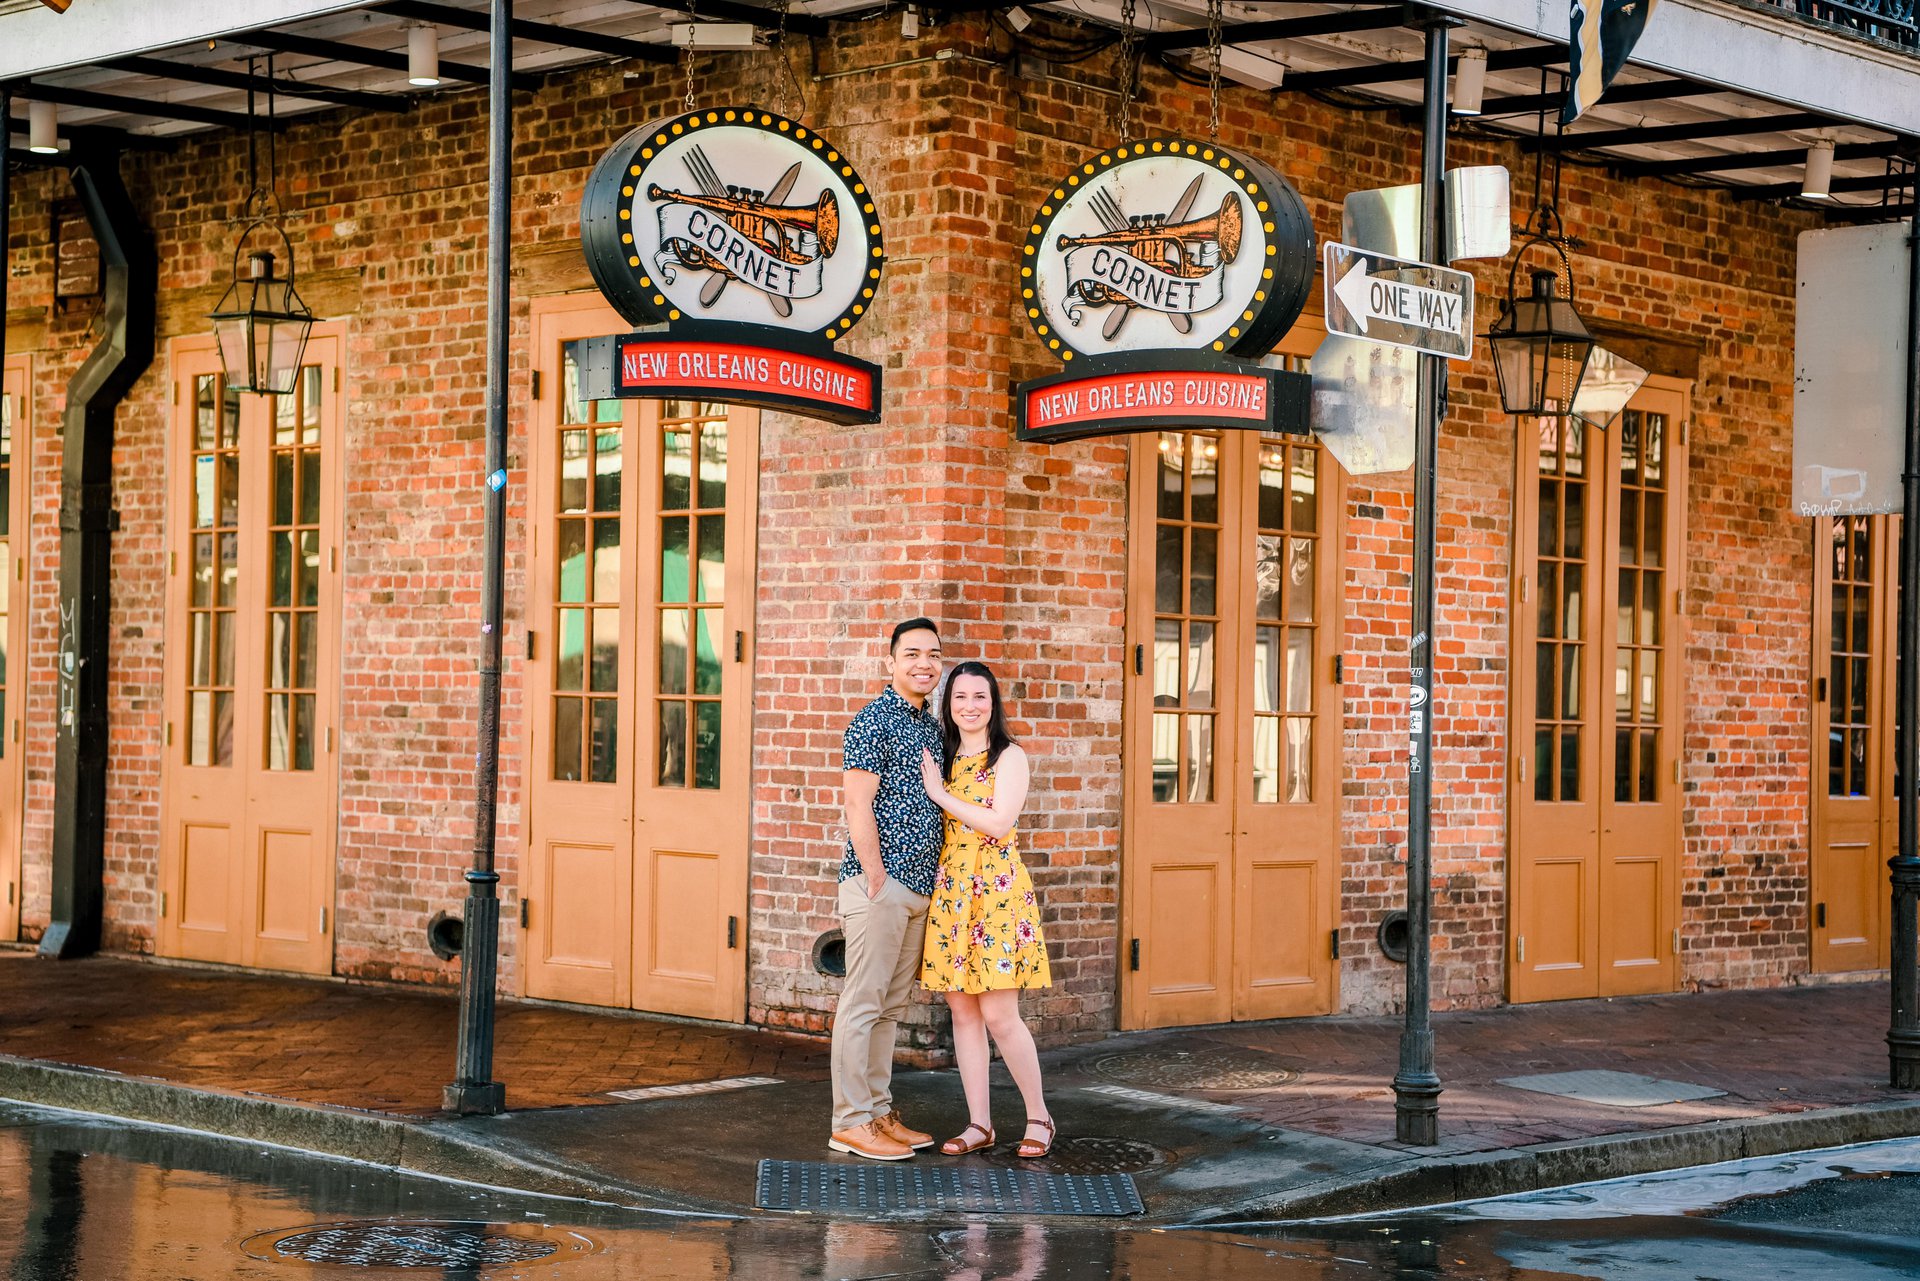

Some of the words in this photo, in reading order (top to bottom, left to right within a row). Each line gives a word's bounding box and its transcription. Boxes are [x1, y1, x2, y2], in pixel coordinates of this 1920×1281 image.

[687, 210, 801, 296] CORNET
[1091, 248, 1200, 310] CORNET
[1370, 281, 1410, 320] ONE
[1418, 290, 1457, 328] WAY
[623, 352, 668, 380] NEW
[678, 352, 769, 382] ORLEANS
[778, 361, 857, 402] CUISINE
[1039, 391, 1079, 421] NEW
[1088, 380, 1175, 411] ORLEANS
[1184, 380, 1264, 410] CUISINE
